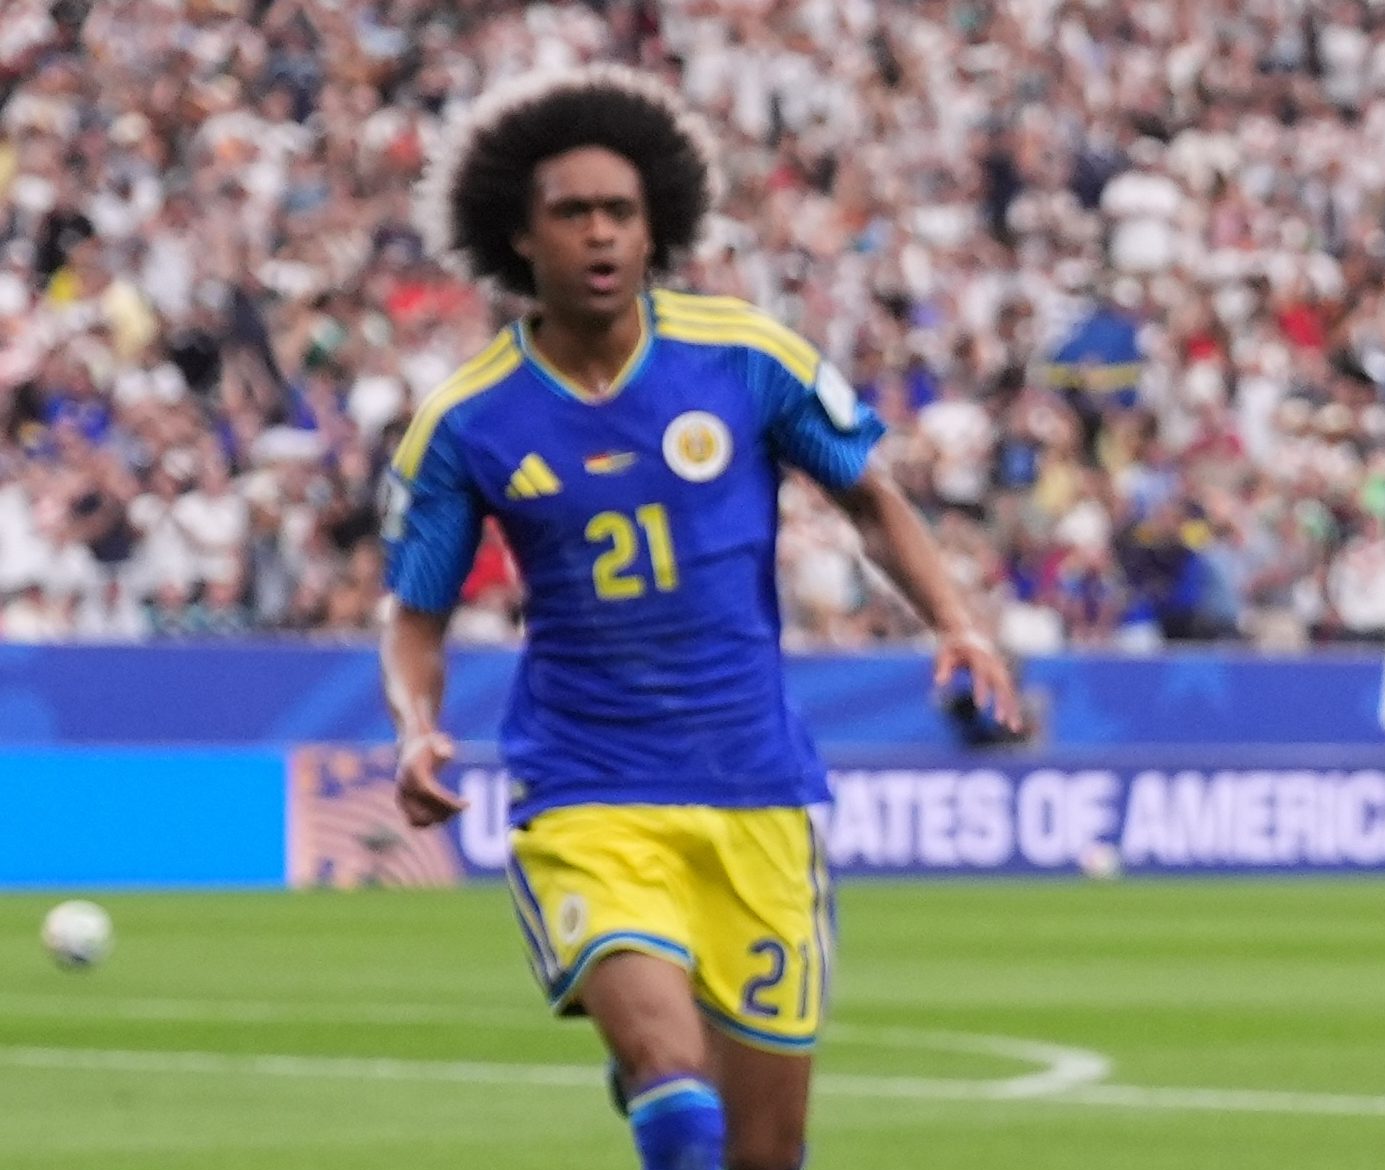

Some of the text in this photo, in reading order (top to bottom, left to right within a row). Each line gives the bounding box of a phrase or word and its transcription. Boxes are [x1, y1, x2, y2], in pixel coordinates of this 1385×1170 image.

[585, 503, 678, 600] 21
[827, 769, 1014, 868] ATES
[1018, 769, 1121, 868] OF
[743, 940, 809, 1018] 21
